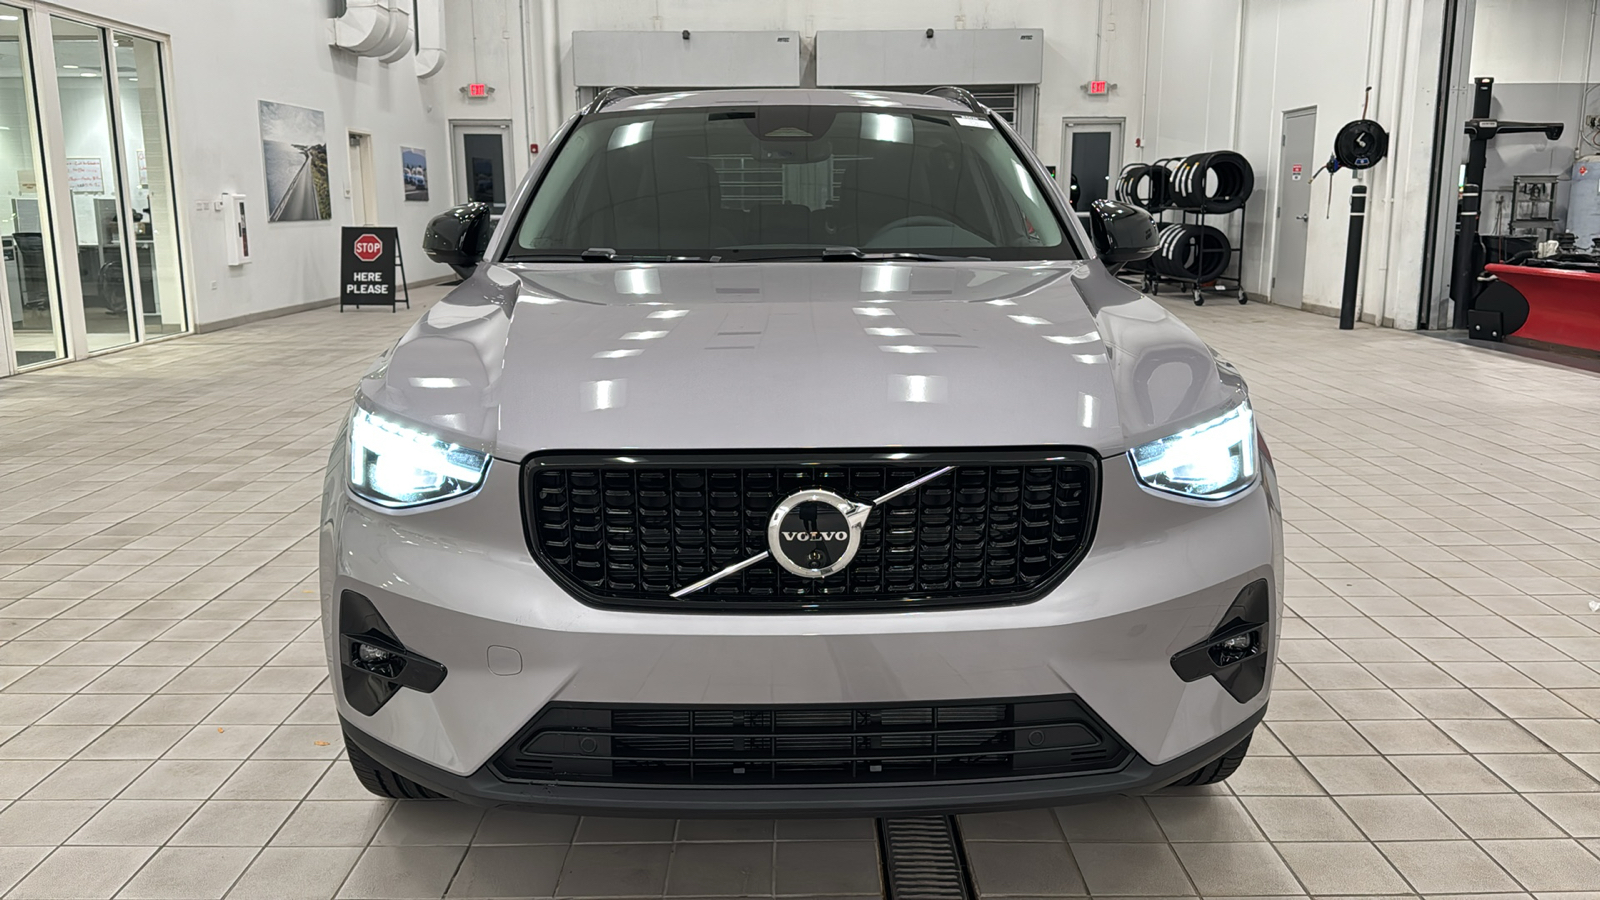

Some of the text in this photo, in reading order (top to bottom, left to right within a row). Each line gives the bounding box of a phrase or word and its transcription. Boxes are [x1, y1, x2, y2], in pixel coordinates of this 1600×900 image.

[356, 242, 380, 253] STOP
[353, 272, 382, 282] HERE
[346, 284, 389, 294] PLEASE
[781, 531, 848, 541] VOLVO
